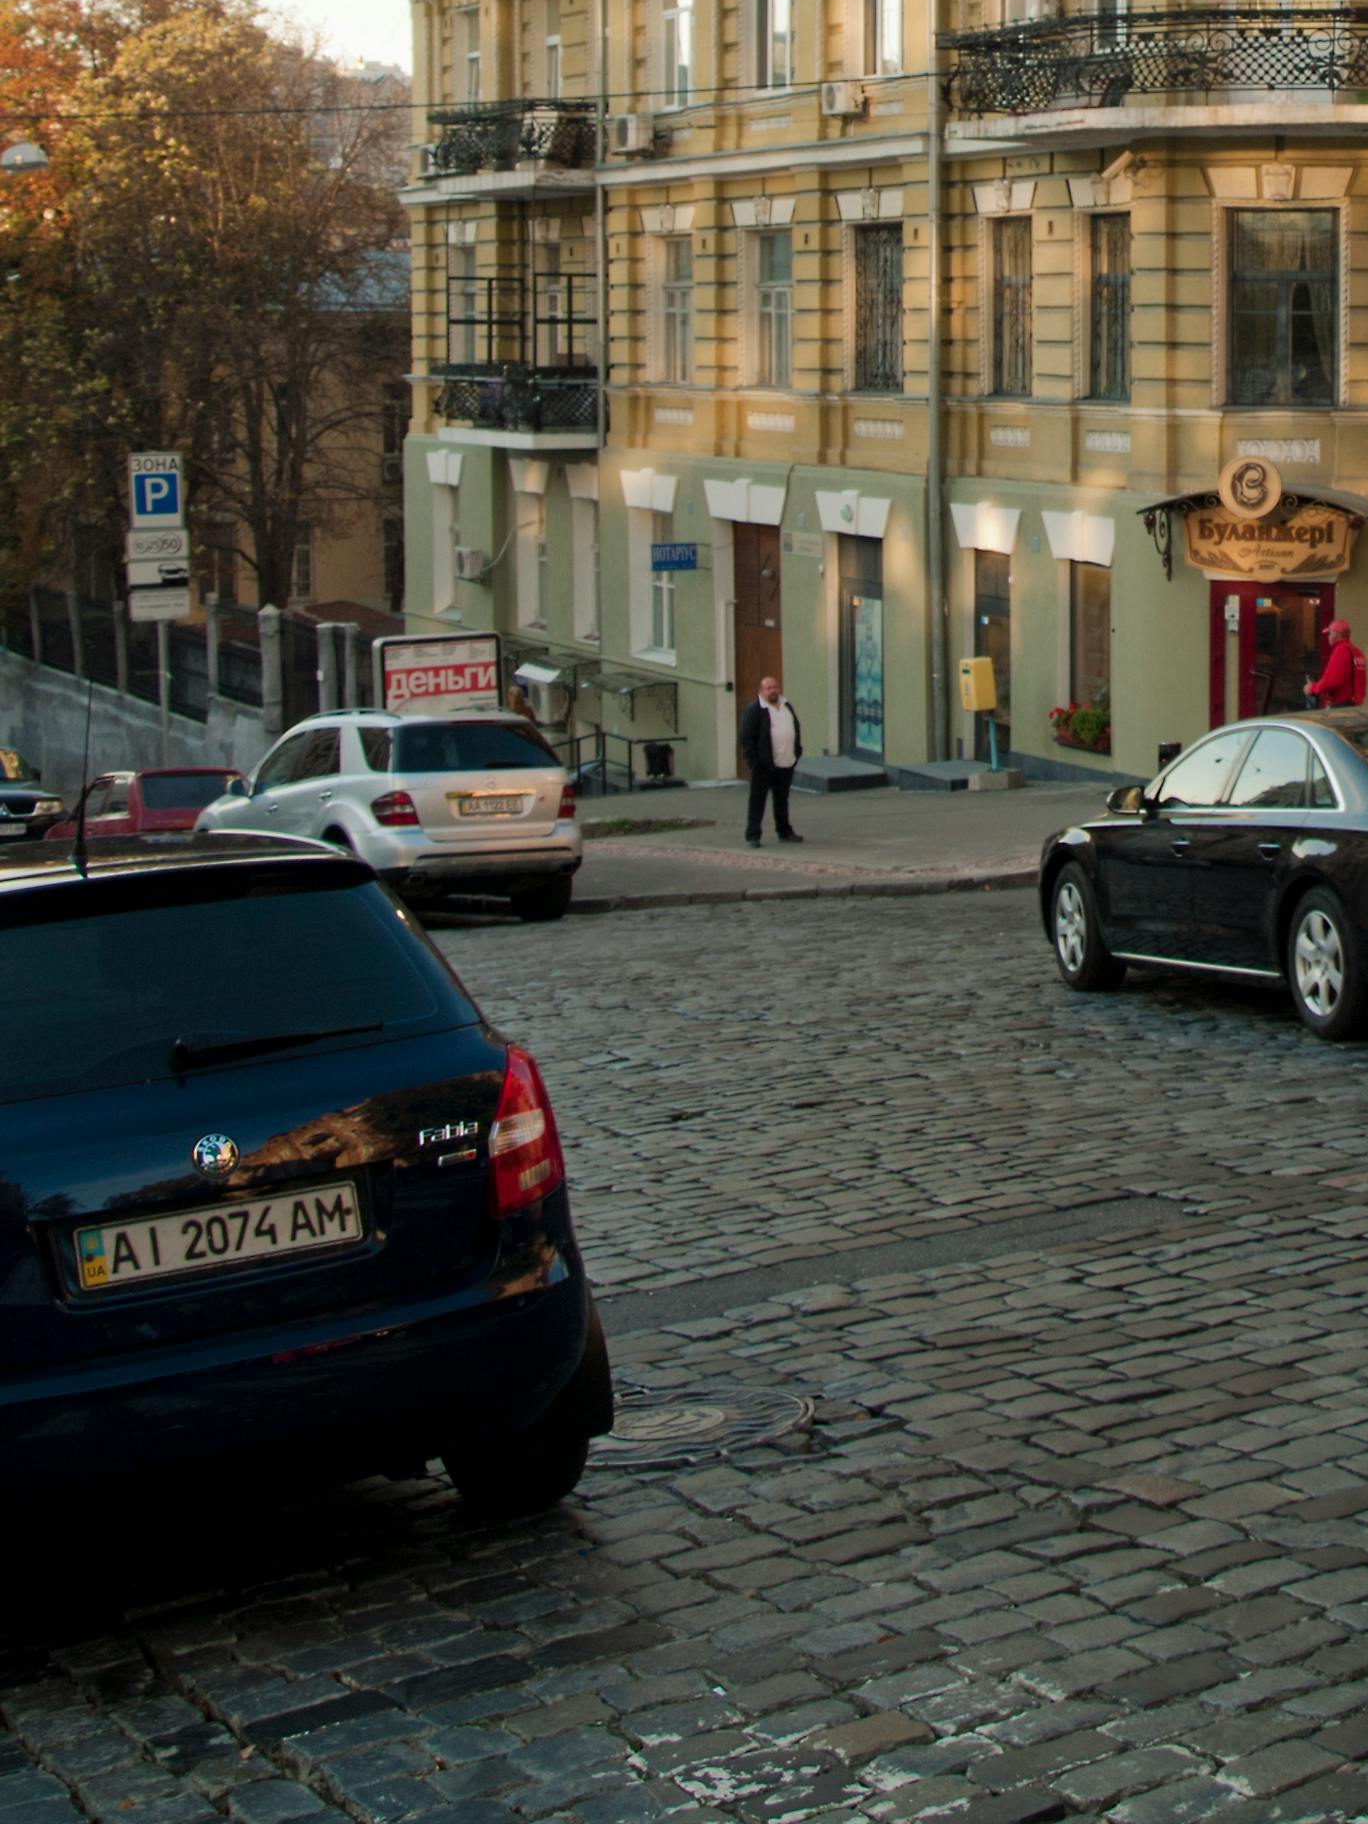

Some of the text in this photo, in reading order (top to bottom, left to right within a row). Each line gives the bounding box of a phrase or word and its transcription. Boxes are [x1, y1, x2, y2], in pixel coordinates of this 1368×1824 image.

[132, 457, 179, 472] ЗОНА
[144, 477, 169, 512] P
[162, 538, 178, 551] 50
[1198, 518, 1335, 549] Буланжері
[1238, 543, 1295, 559] Artisan
[387, 666, 497, 702] деньги
[418, 1119, 479, 1146] Fabia
[112, 1194, 348, 1275] AI 2074 AM
[87, 1265, 107, 1278] UA
